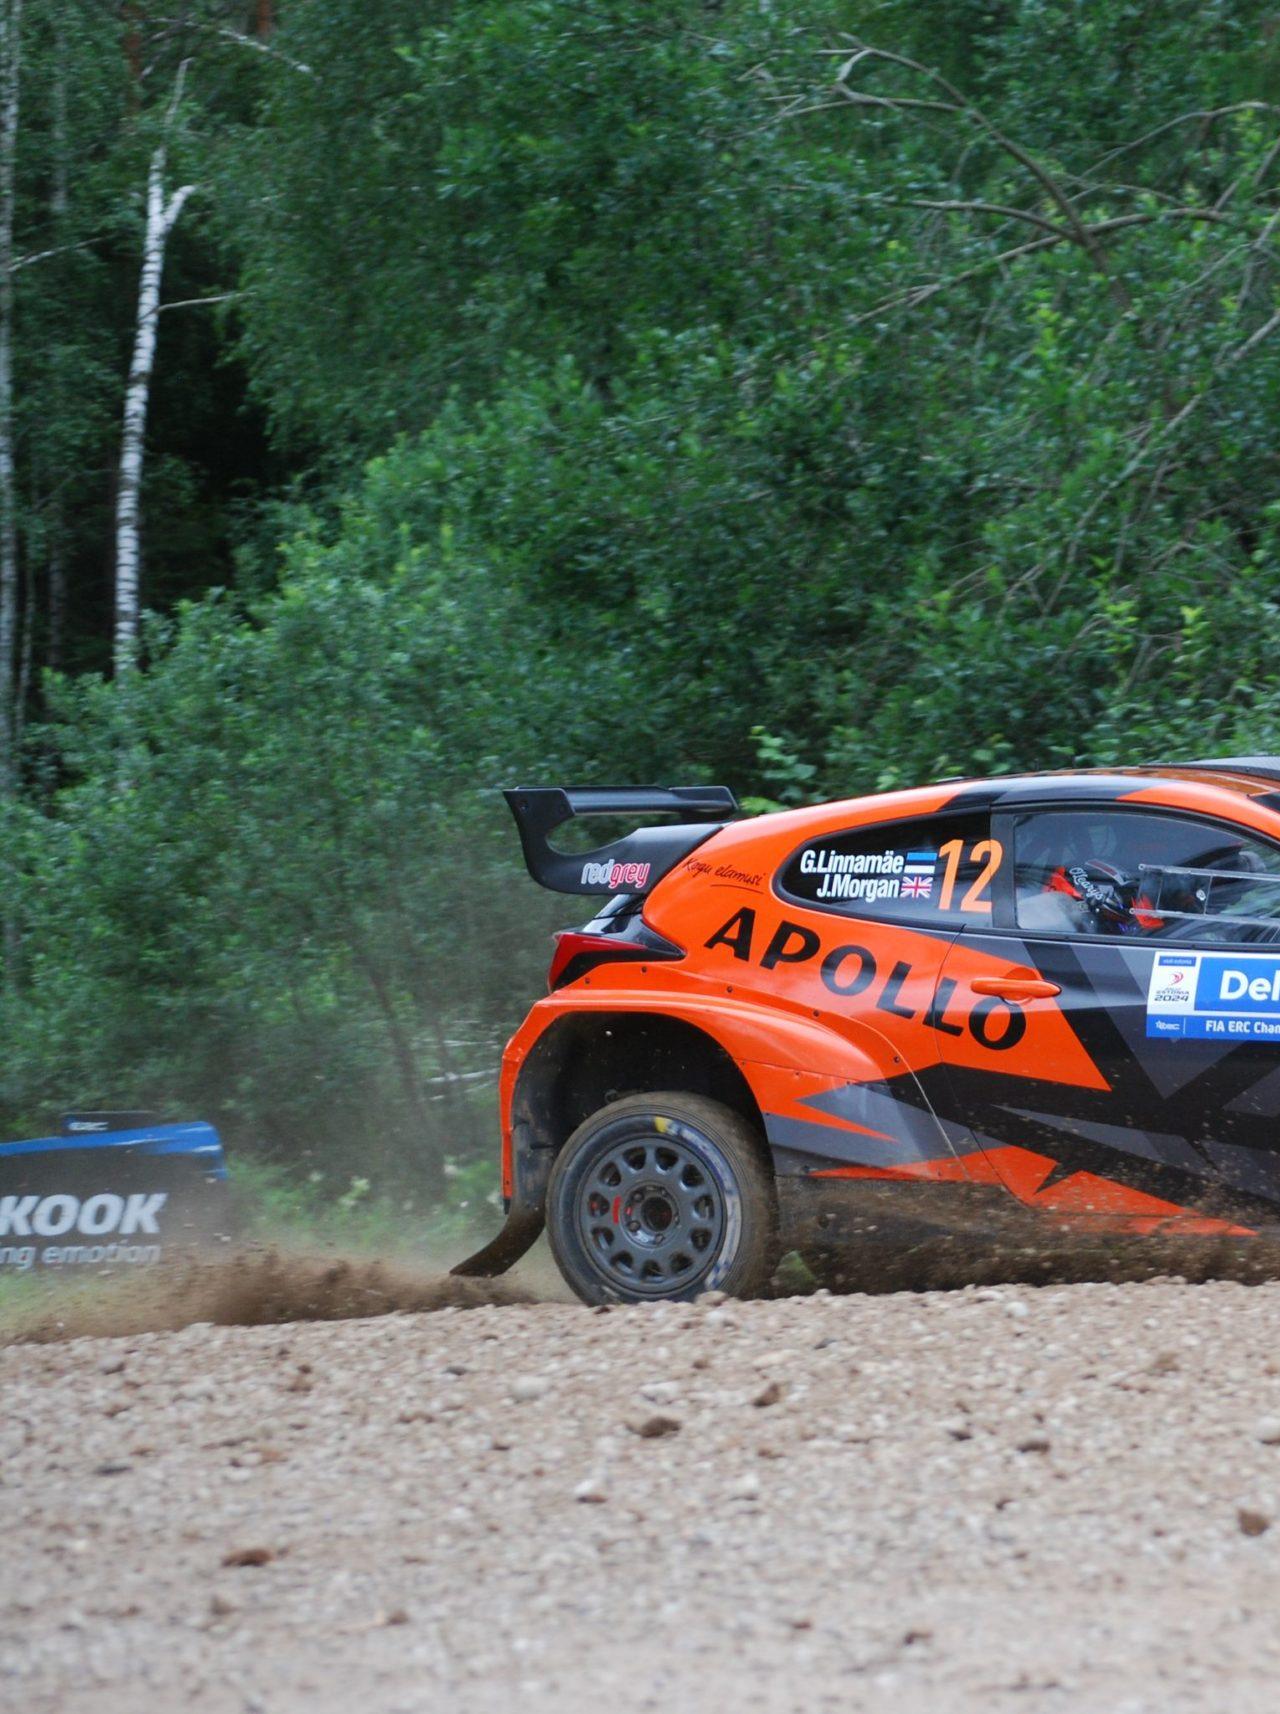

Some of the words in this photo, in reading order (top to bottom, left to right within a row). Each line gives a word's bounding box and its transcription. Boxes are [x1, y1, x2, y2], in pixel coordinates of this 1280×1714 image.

[581, 859, 651, 889] redgrey
[801, 850, 905, 873] G.Linnamäe
[816, 873, 900, 903] J.Morgan
[938, 839, 1003, 914] 12
[704, 907, 1027, 1051] APOLLO
[1154, 994, 1189, 1002] 2024
[1206, 1020, 1225, 1032] FIA
[1228, 1021, 1251, 1034] ERC
[42, 1239, 161, 1264] emotion
